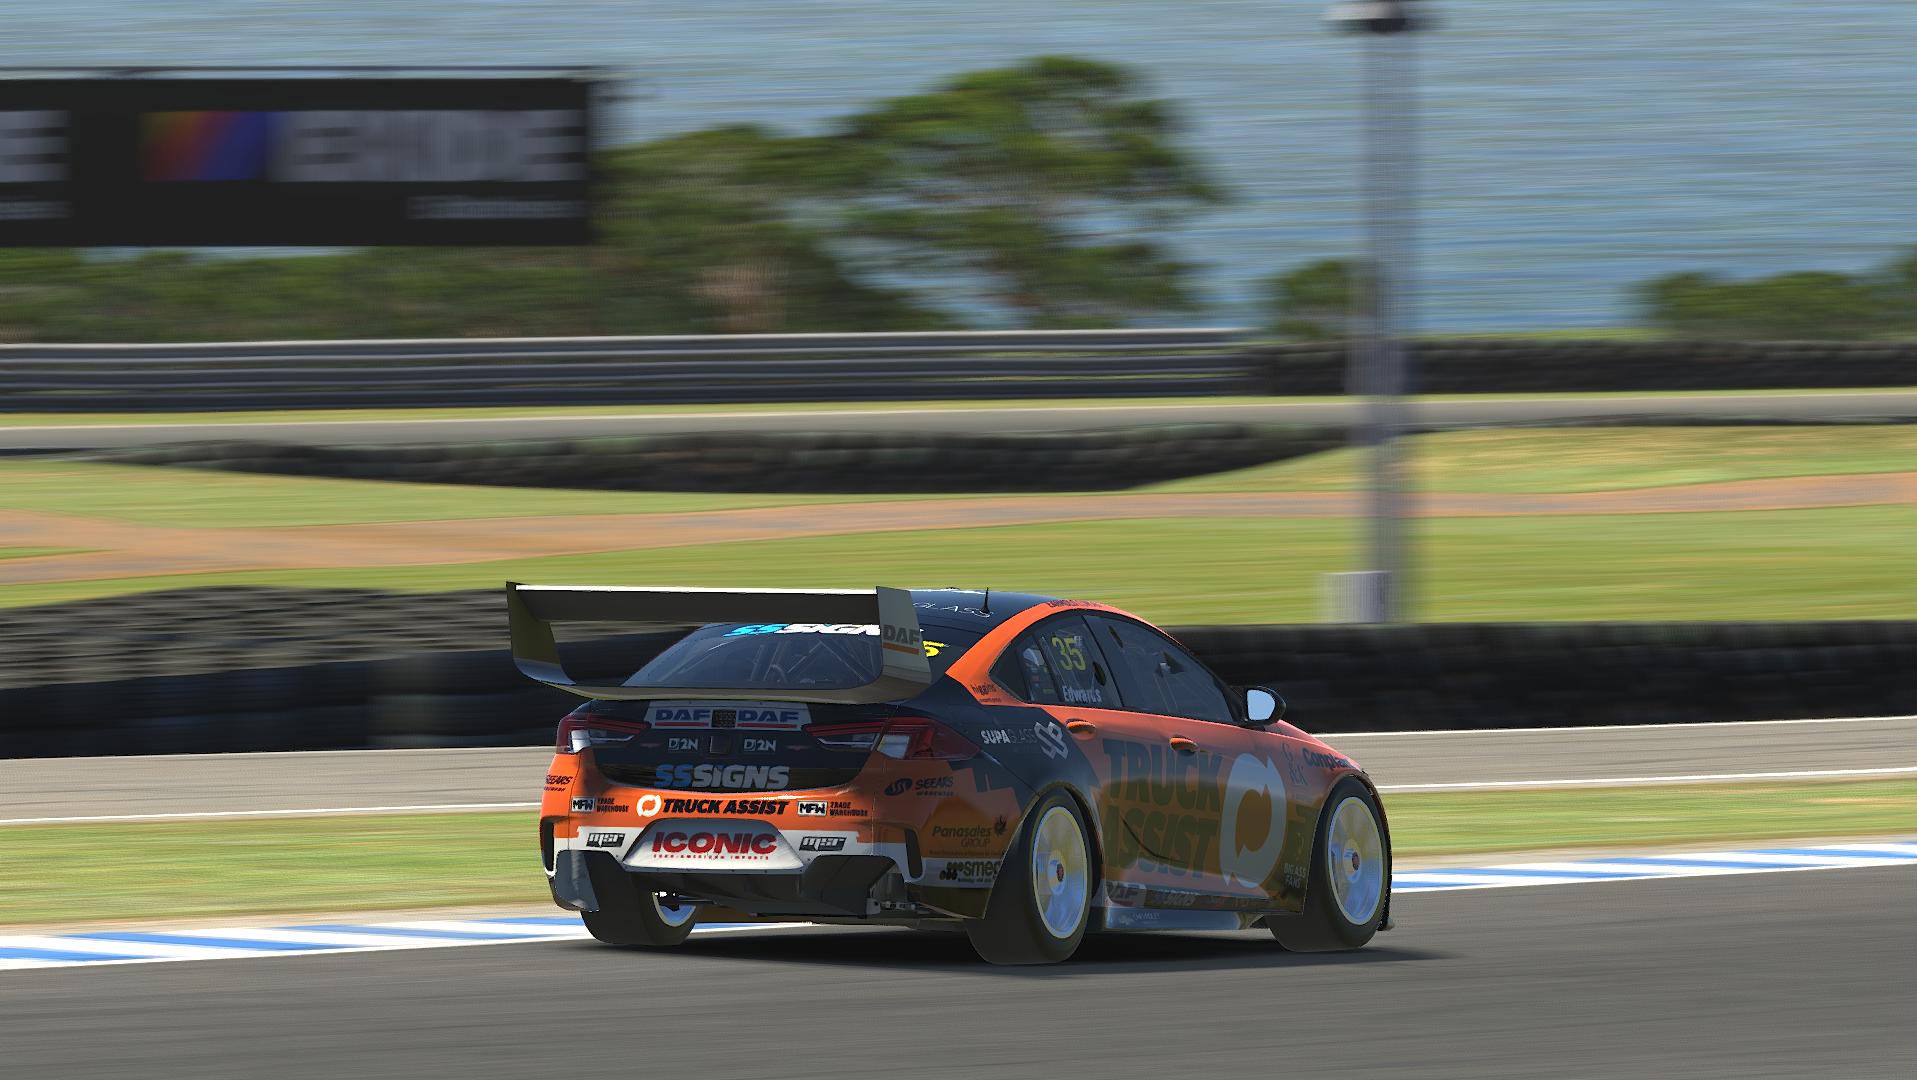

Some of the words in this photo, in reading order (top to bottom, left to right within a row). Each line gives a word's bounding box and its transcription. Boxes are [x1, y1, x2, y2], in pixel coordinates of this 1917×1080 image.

[883, 624, 921, 647] DAF
[1051, 635, 1086, 671] 35
[1062, 685, 1102, 704] Edwards
[655, 709, 711, 721] DAF
[738, 710, 800, 722] DAF
[1102, 738, 1225, 813] TRUCK
[572, 799, 594, 812] MFW
[663, 799, 721, 814] TRUCK
[723, 799, 790, 815] ASSIST
[799, 802, 825, 814] MFW
[932, 824, 993, 838] Panasales
[652, 831, 777, 855] ICONIC
[1102, 803, 1220, 879] ASSIST
